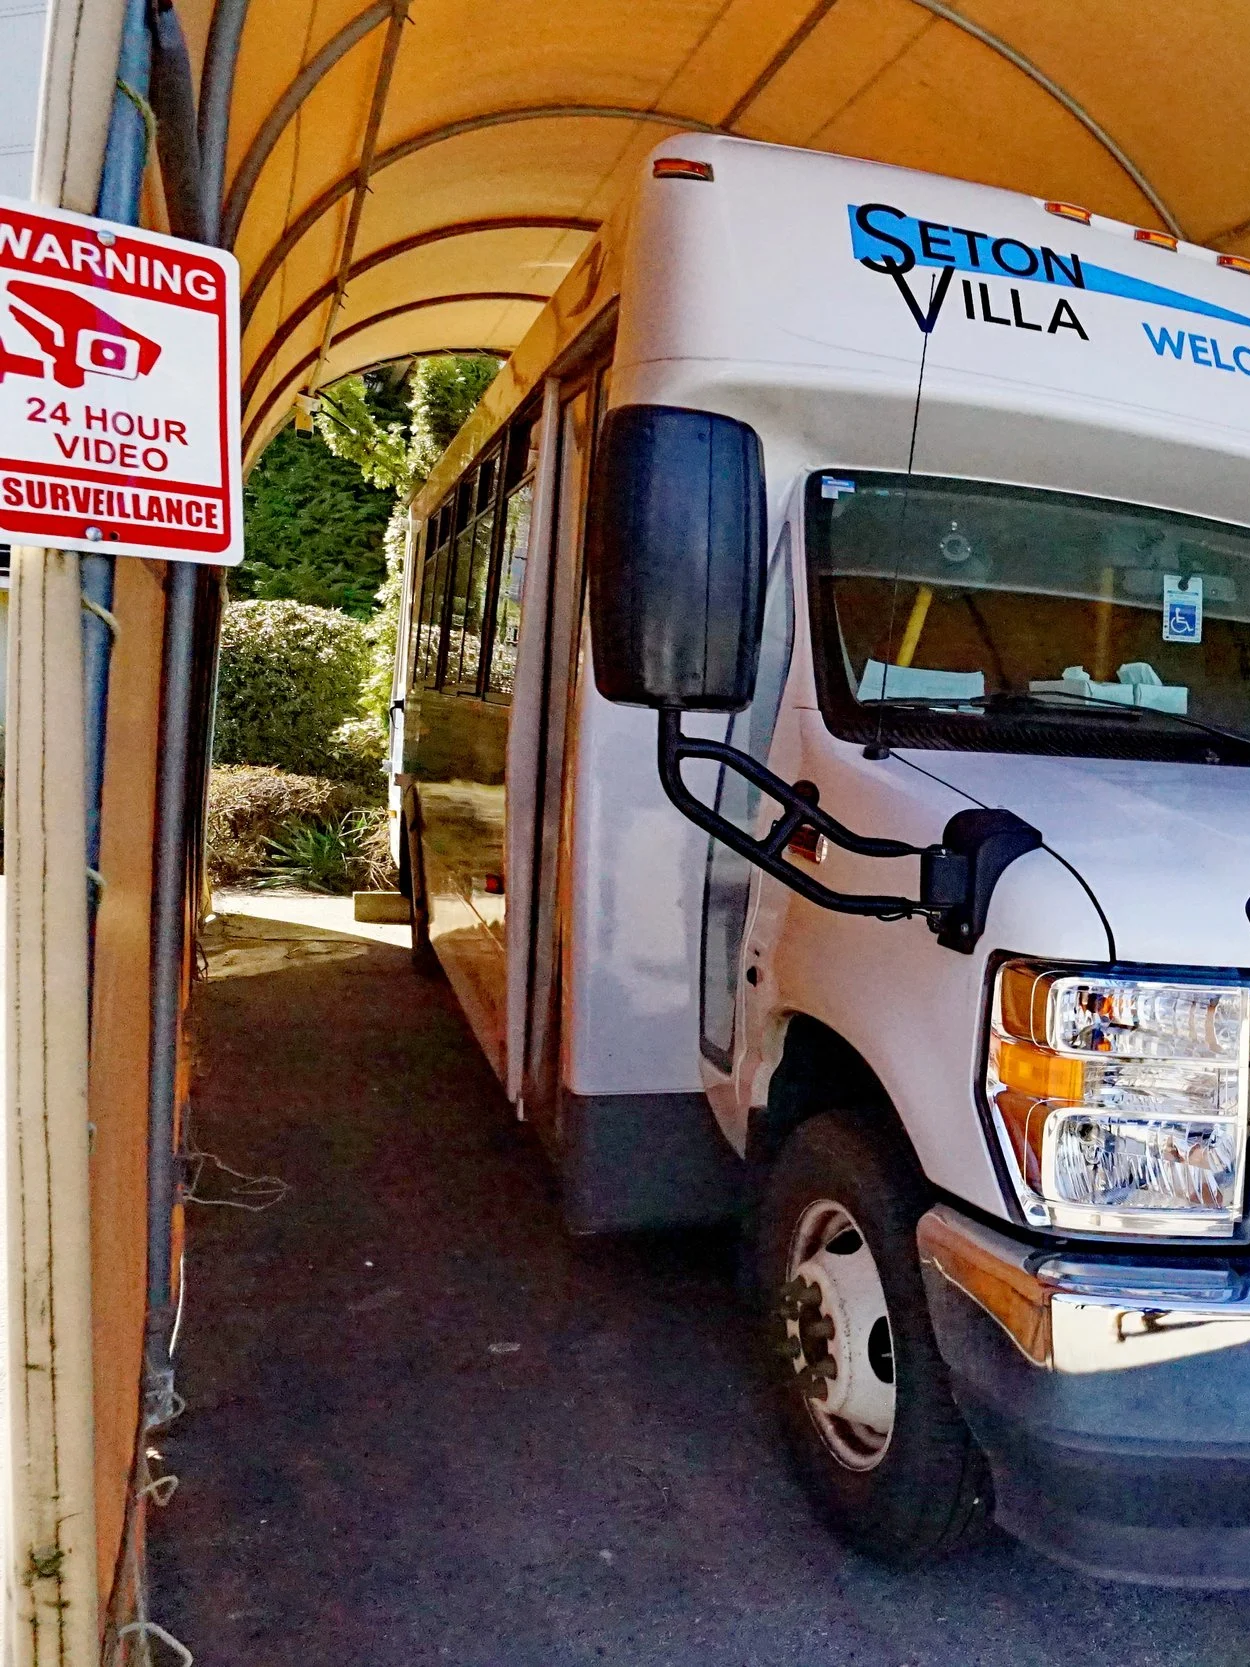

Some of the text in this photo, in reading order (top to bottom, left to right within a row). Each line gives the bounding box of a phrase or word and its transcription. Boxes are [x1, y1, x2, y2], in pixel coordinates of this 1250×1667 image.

[0, 222, 217, 302] WARNING
[855, 202, 1086, 289] SETON
[881, 253, 1090, 342] VILLA
[26, 396, 189, 446] 24 HOUR
[54, 432, 169, 472] VIDEO
[2, 476, 219, 530] SURVEILLANCE
